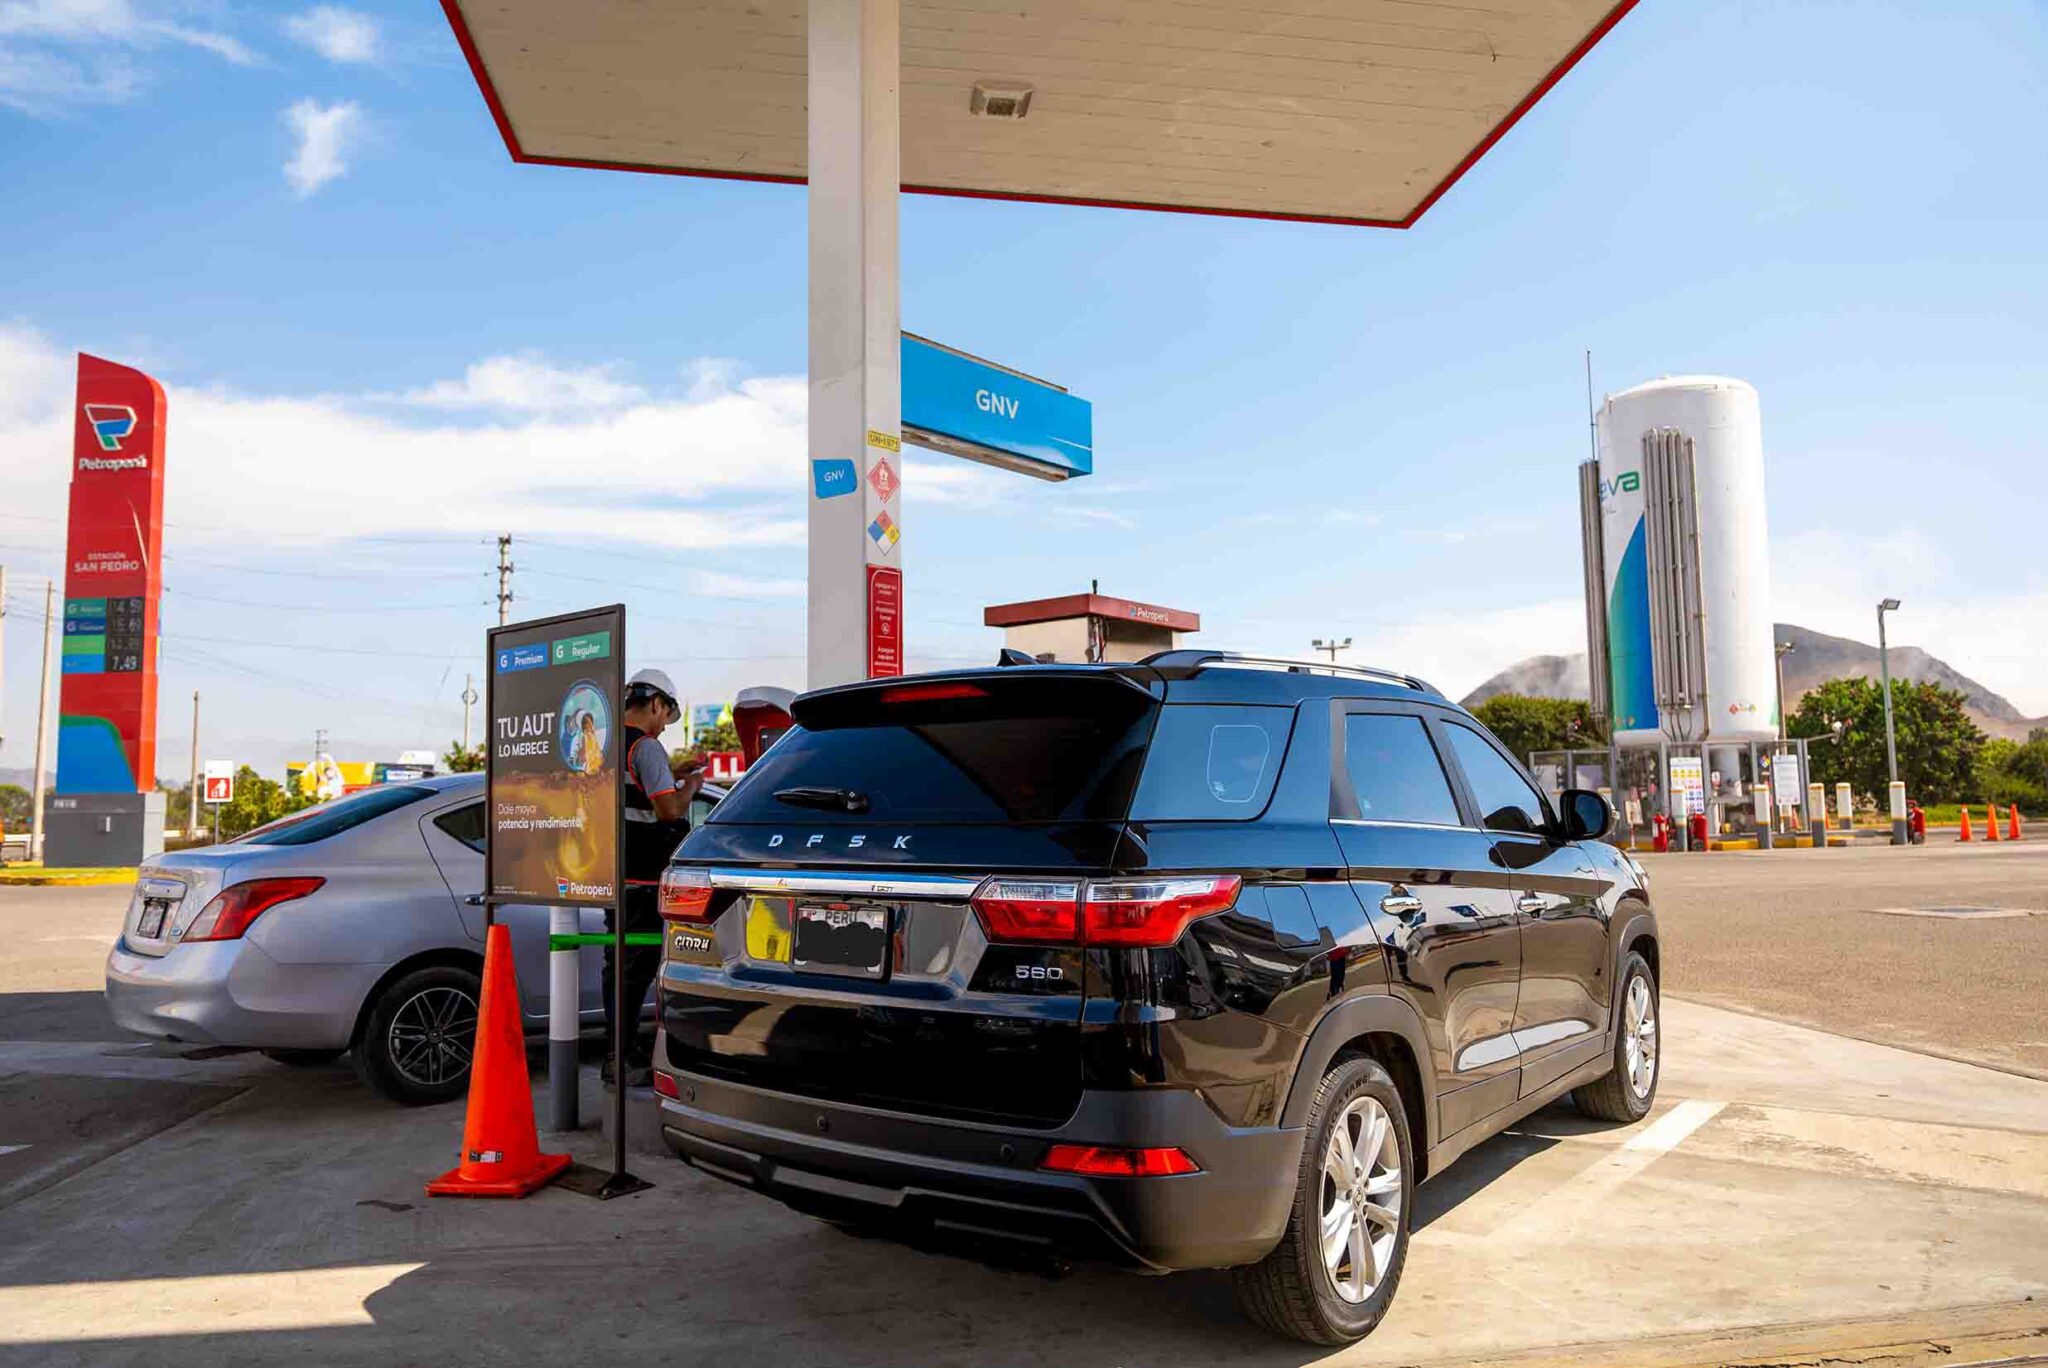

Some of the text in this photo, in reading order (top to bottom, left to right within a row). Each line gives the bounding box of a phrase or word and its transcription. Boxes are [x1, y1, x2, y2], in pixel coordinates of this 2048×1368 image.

[976, 389, 1019, 419] GNV
[79, 454, 147, 472] Petroperú
[824, 470, 845, 482] GNV
[75, 560, 139, 573] SAN PEDRO
[1137, 607, 1169, 623] Petroperú
[556, 644, 600, 659] G Regular
[112, 655, 137, 671] 7.49
[501, 653, 544, 668] G Premium
[498, 712, 556, 740] TU AUT
[498, 740, 549, 758] LO MERECE
[498, 803, 537, 816] Dale mayor
[498, 817, 529, 832] potencia
[570, 882, 612, 898] Petroperú
[1015, 965, 1063, 980] 560
